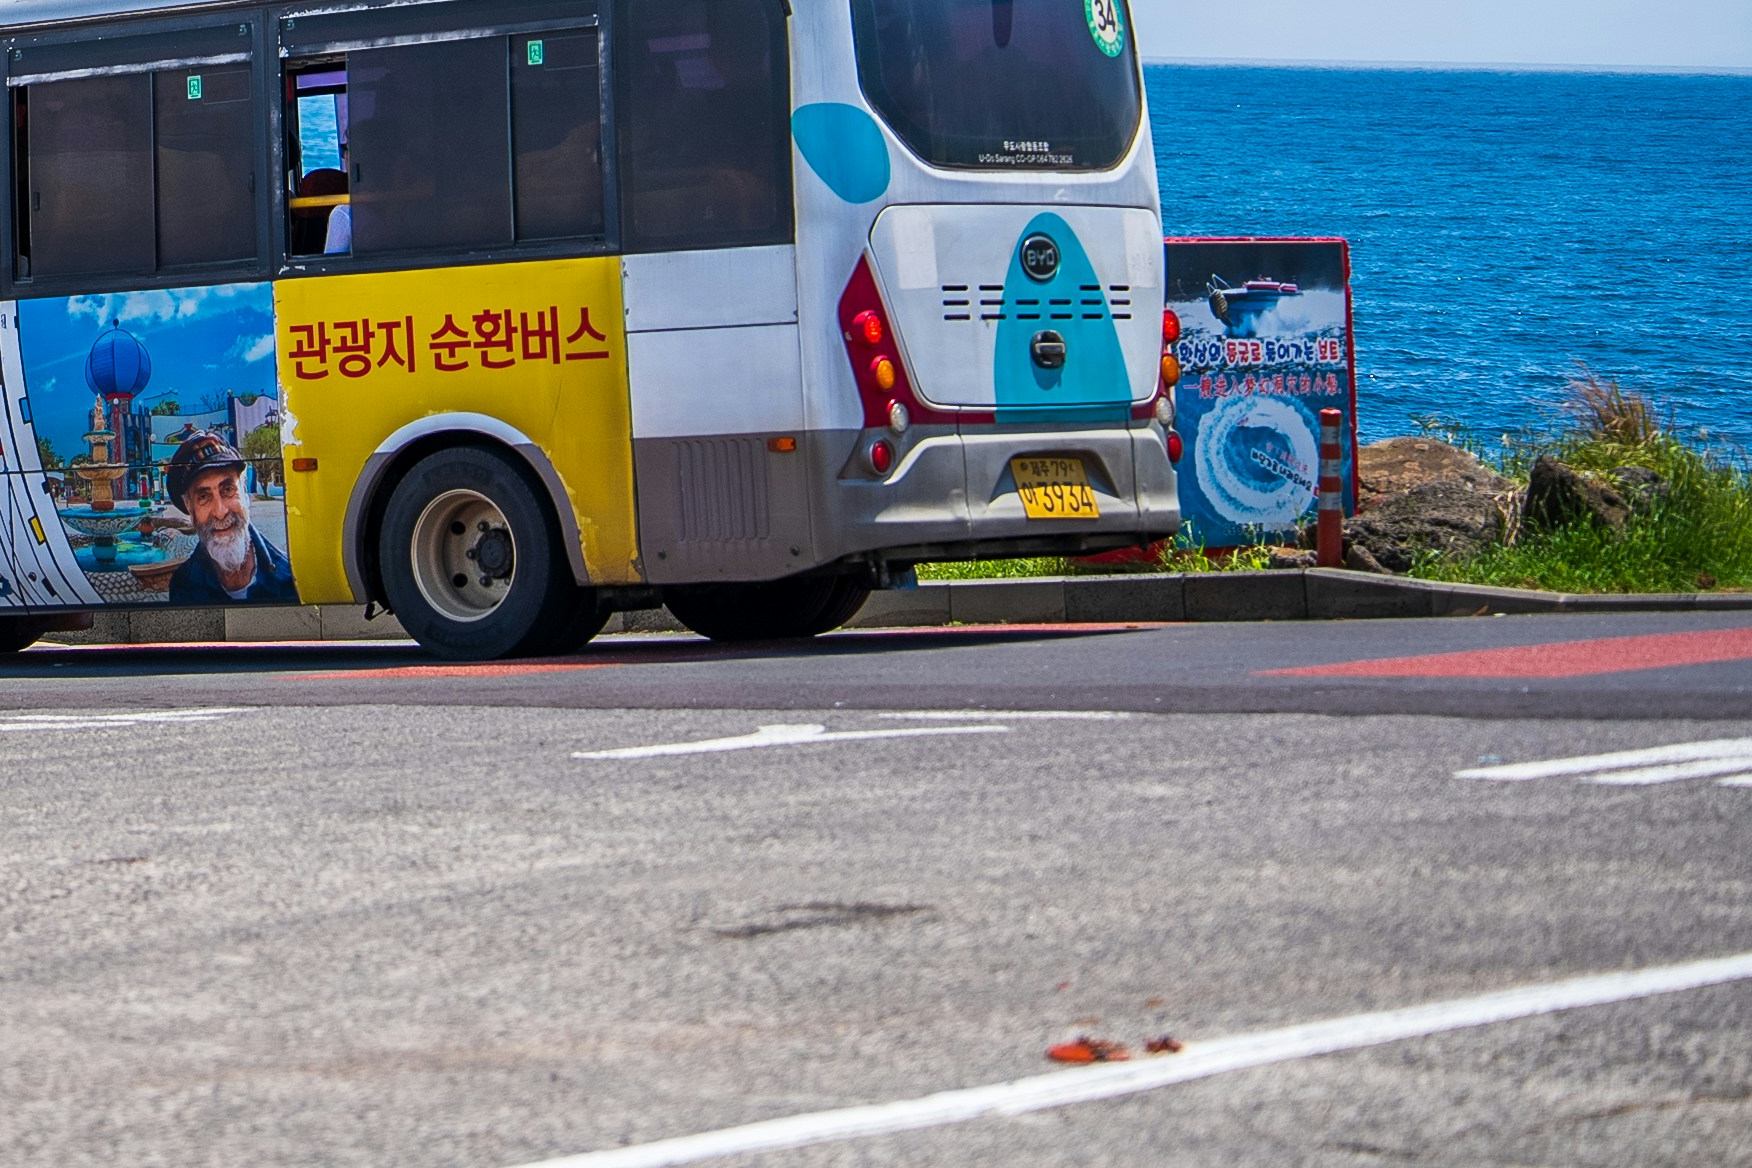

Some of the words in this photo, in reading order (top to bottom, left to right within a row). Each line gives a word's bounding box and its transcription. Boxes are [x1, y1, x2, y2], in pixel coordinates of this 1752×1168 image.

[1028, 248, 1055, 266] BYD
[289, 315, 415, 380] 관광지
[429, 305, 610, 373] 순환버스
[1227, 340, 1262, 363] 동굴로
[1265, 340, 1315, 362] 들어가는
[1317, 339, 1339, 361] 보트
